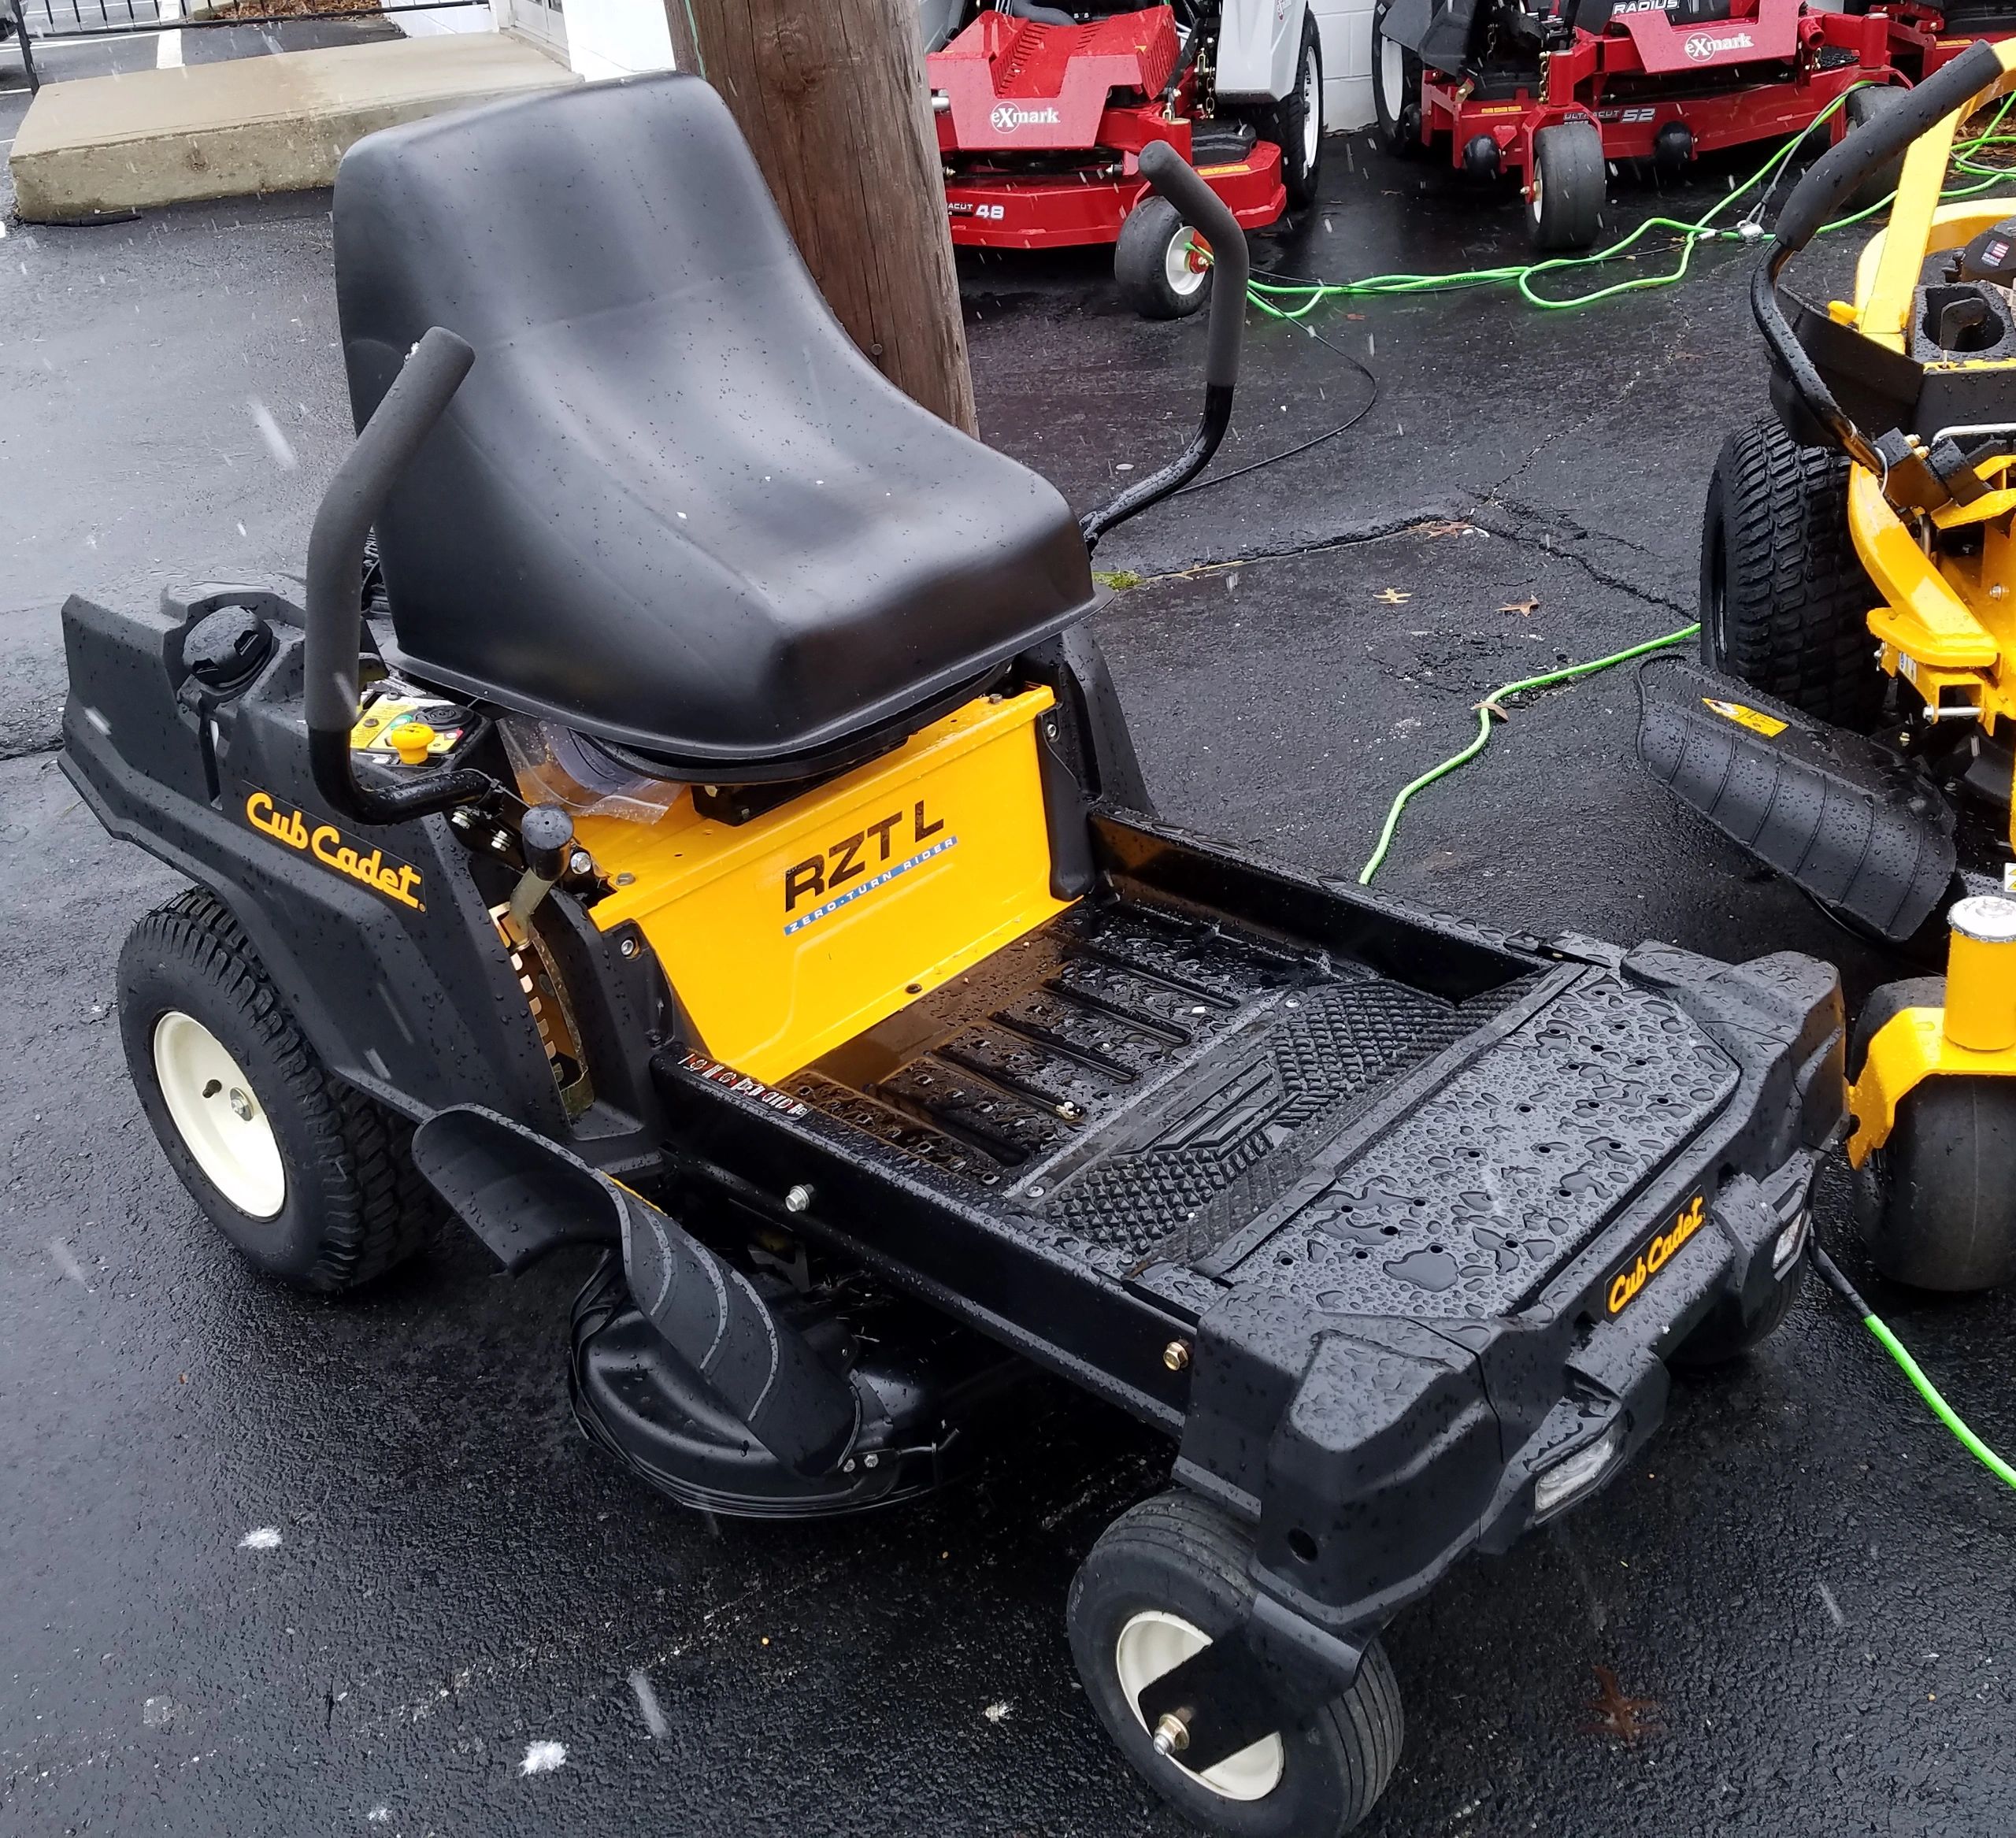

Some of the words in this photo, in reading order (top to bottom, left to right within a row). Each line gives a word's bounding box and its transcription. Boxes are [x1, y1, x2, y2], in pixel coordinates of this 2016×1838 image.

[1613, 0, 1680, 15] RADIUS
[1622, 108, 1655, 122] 52
[976, 205, 1005, 219] 48
[246, 792, 309, 850] Cub
[311, 825, 422, 910] Cadet
[785, 810, 903, 913] RZT
[914, 799, 944, 843] L
[903, 837, 954, 870] RIDER
[1609, 1256, 1647, 1314] Cub
[1647, 1195, 1704, 1274] Cadet
